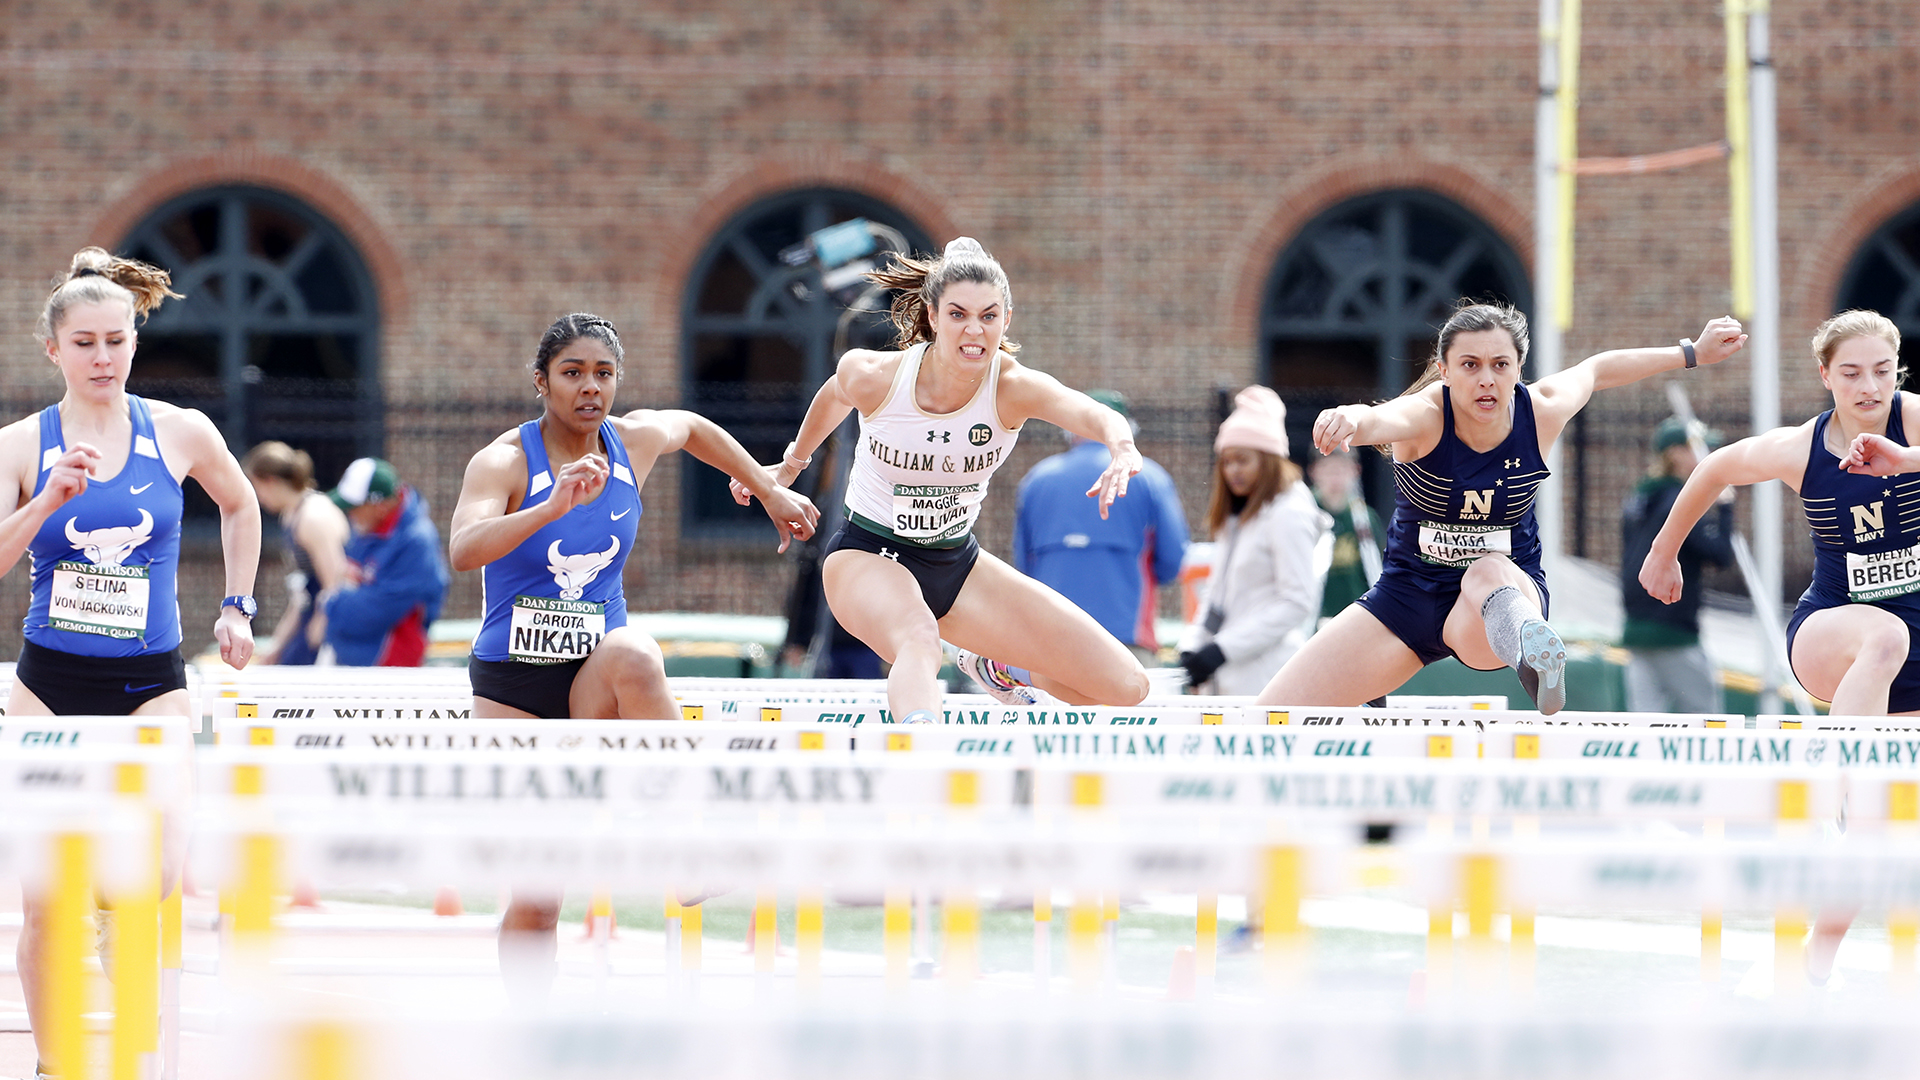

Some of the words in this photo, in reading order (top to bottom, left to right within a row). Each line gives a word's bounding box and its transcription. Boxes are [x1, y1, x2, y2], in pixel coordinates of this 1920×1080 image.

[971, 428, 990, 442] DS
[869, 436, 935, 472] WILLIAM
[942, 455, 956, 473] &
[964, 446, 1003, 473] MARY
[902, 486, 925, 496] DAN
[926, 486, 976, 496] STIMSON
[913, 494, 961, 510] MAGGIE
[1460, 489, 1495, 514] N
[896, 506, 968, 531] SULLIVAN
[1458, 513, 1490, 521] NAVY
[1850, 500, 1885, 535] N
[1427, 521, 1451, 531] DAN
[1452, 524, 1504, 532] STIMSON
[1432, 531, 1487, 547] ALYSSA
[1854, 529, 1885, 544] NAVY
[1866, 547, 1913, 563] EVELYN
[62, 562, 88, 573] DAN
[90, 565, 144, 578] STIMSON
[75, 576, 127, 594] SELINA
[1857, 587, 1905, 601] MEMORIAL
[54, 595, 76, 610] VON
[79, 600, 144, 618] JACKOWSKI
[521, 597, 548, 608] DAN
[549, 601, 598, 614] STIMSON
[55, 620, 109, 636] MEMORIAL
[110, 628, 138, 638] QUAD
[533, 612, 585, 629] CAROTA
[20, 731, 81, 748] GILL
[294, 734, 346, 749] GILL
[372, 734, 539, 750] WILLIAM
[599, 735, 705, 750] MARY
[727, 736, 778, 751] GILL
[956, 739, 1015, 756] GILL
[1033, 734, 1166, 757] WILLIAM
[1214, 734, 1299, 758] MARY
[1312, 739, 1374, 757] GILL
[1581, 740, 1641, 758] GILL
[1658, 736, 1792, 764] WILLIAM
[1837, 738, 1920, 766] MARY
